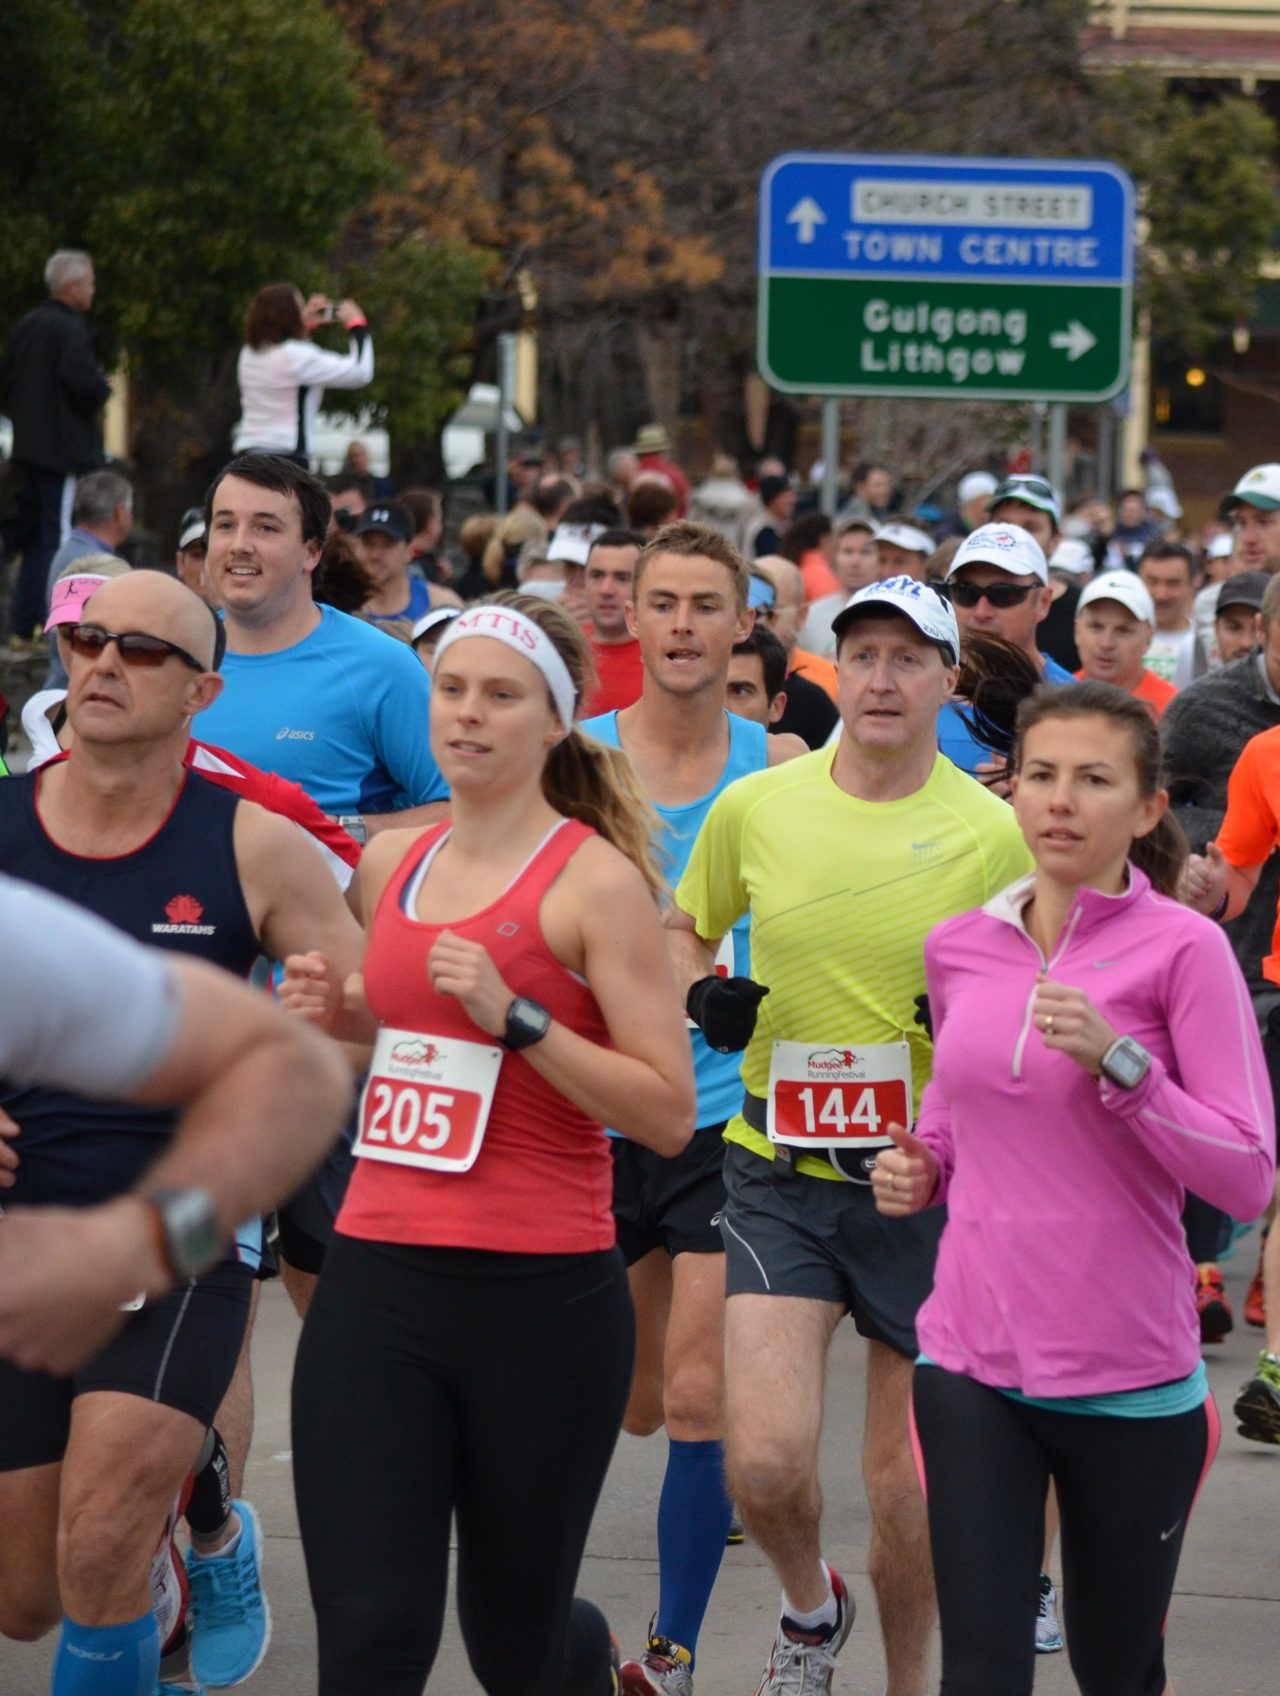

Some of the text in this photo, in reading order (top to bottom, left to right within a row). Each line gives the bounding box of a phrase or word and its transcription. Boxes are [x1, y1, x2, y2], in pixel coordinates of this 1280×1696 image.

[861, 191, 1080, 220] CHURCH STREET
[843, 231, 1099, 268] TOWN CENTRE
[863, 299, 1028, 344] Gulgong
[861, 340, 1027, 383] Lithgow
[288, 729, 315, 741] asics
[152, 923, 216, 936] WARATAHS
[808, 1060, 844, 1072] Mudgee
[808, 1069, 866, 1080] RunningFestival
[367, 1083, 455, 1151] 205
[798, 1087, 882, 1133] 144
